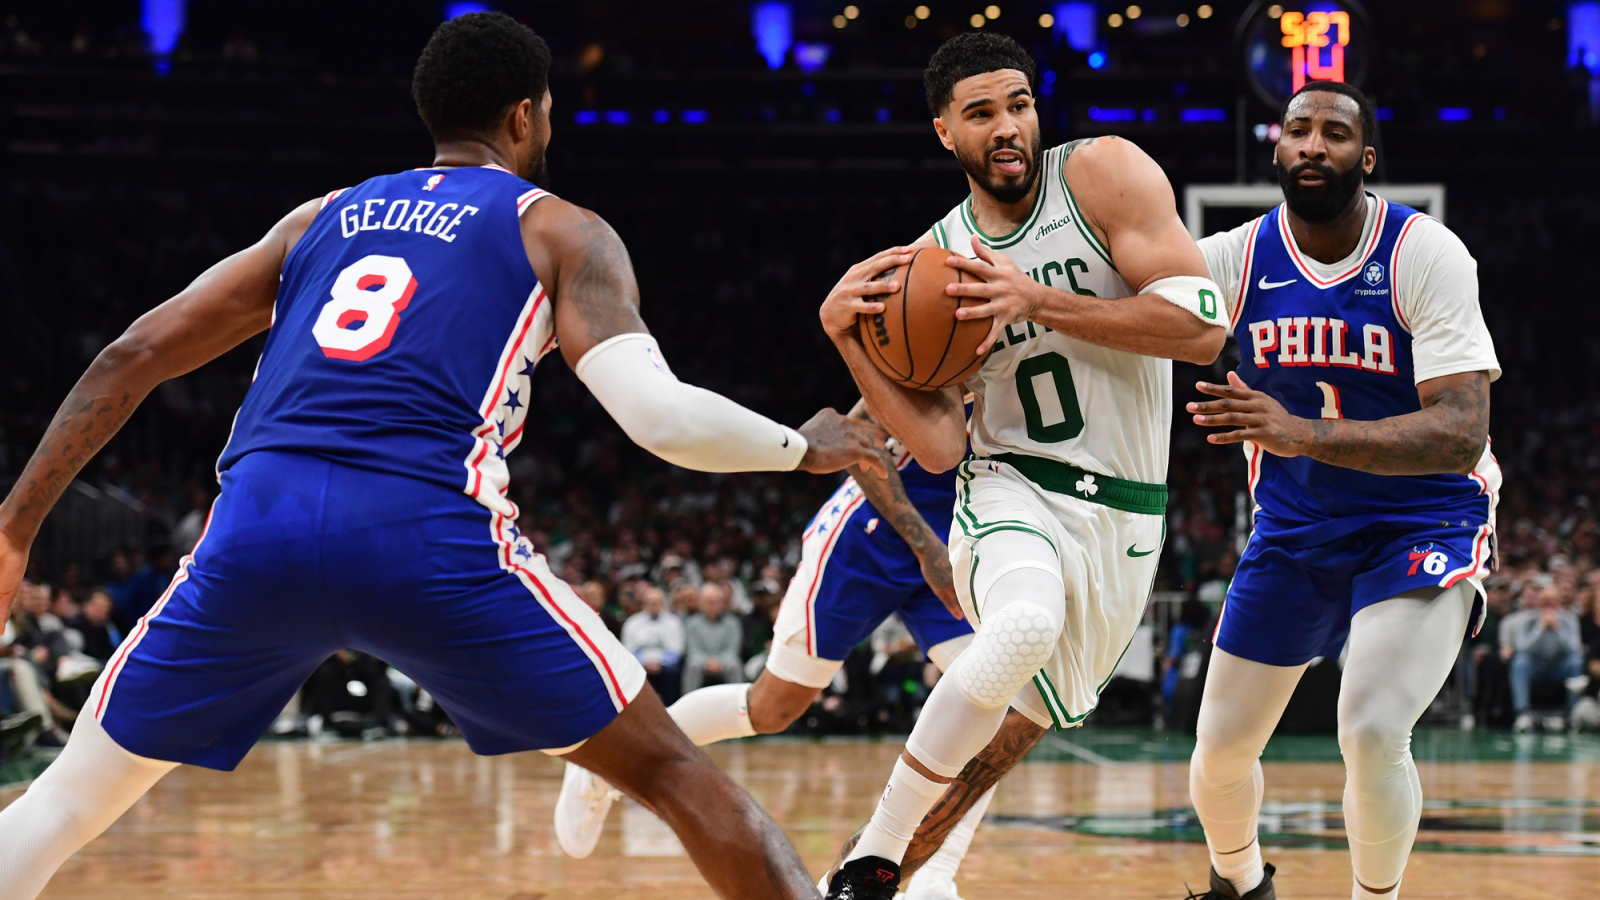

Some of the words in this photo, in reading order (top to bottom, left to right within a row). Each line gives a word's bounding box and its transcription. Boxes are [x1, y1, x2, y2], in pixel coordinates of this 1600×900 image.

[1292, 43, 1345, 95] 14
[340, 199, 479, 243] GEORGE
[1035, 215, 1070, 241] Amica
[312, 255, 419, 362] 8
[1198, 288, 1217, 320] 0
[1354, 288, 1390, 296] crypto.com
[1248, 316, 1399, 376] PHILA
[1014, 350, 1085, 444] 0
[1315, 381, 1344, 420] 1
[1407, 550, 1449, 577] 76
